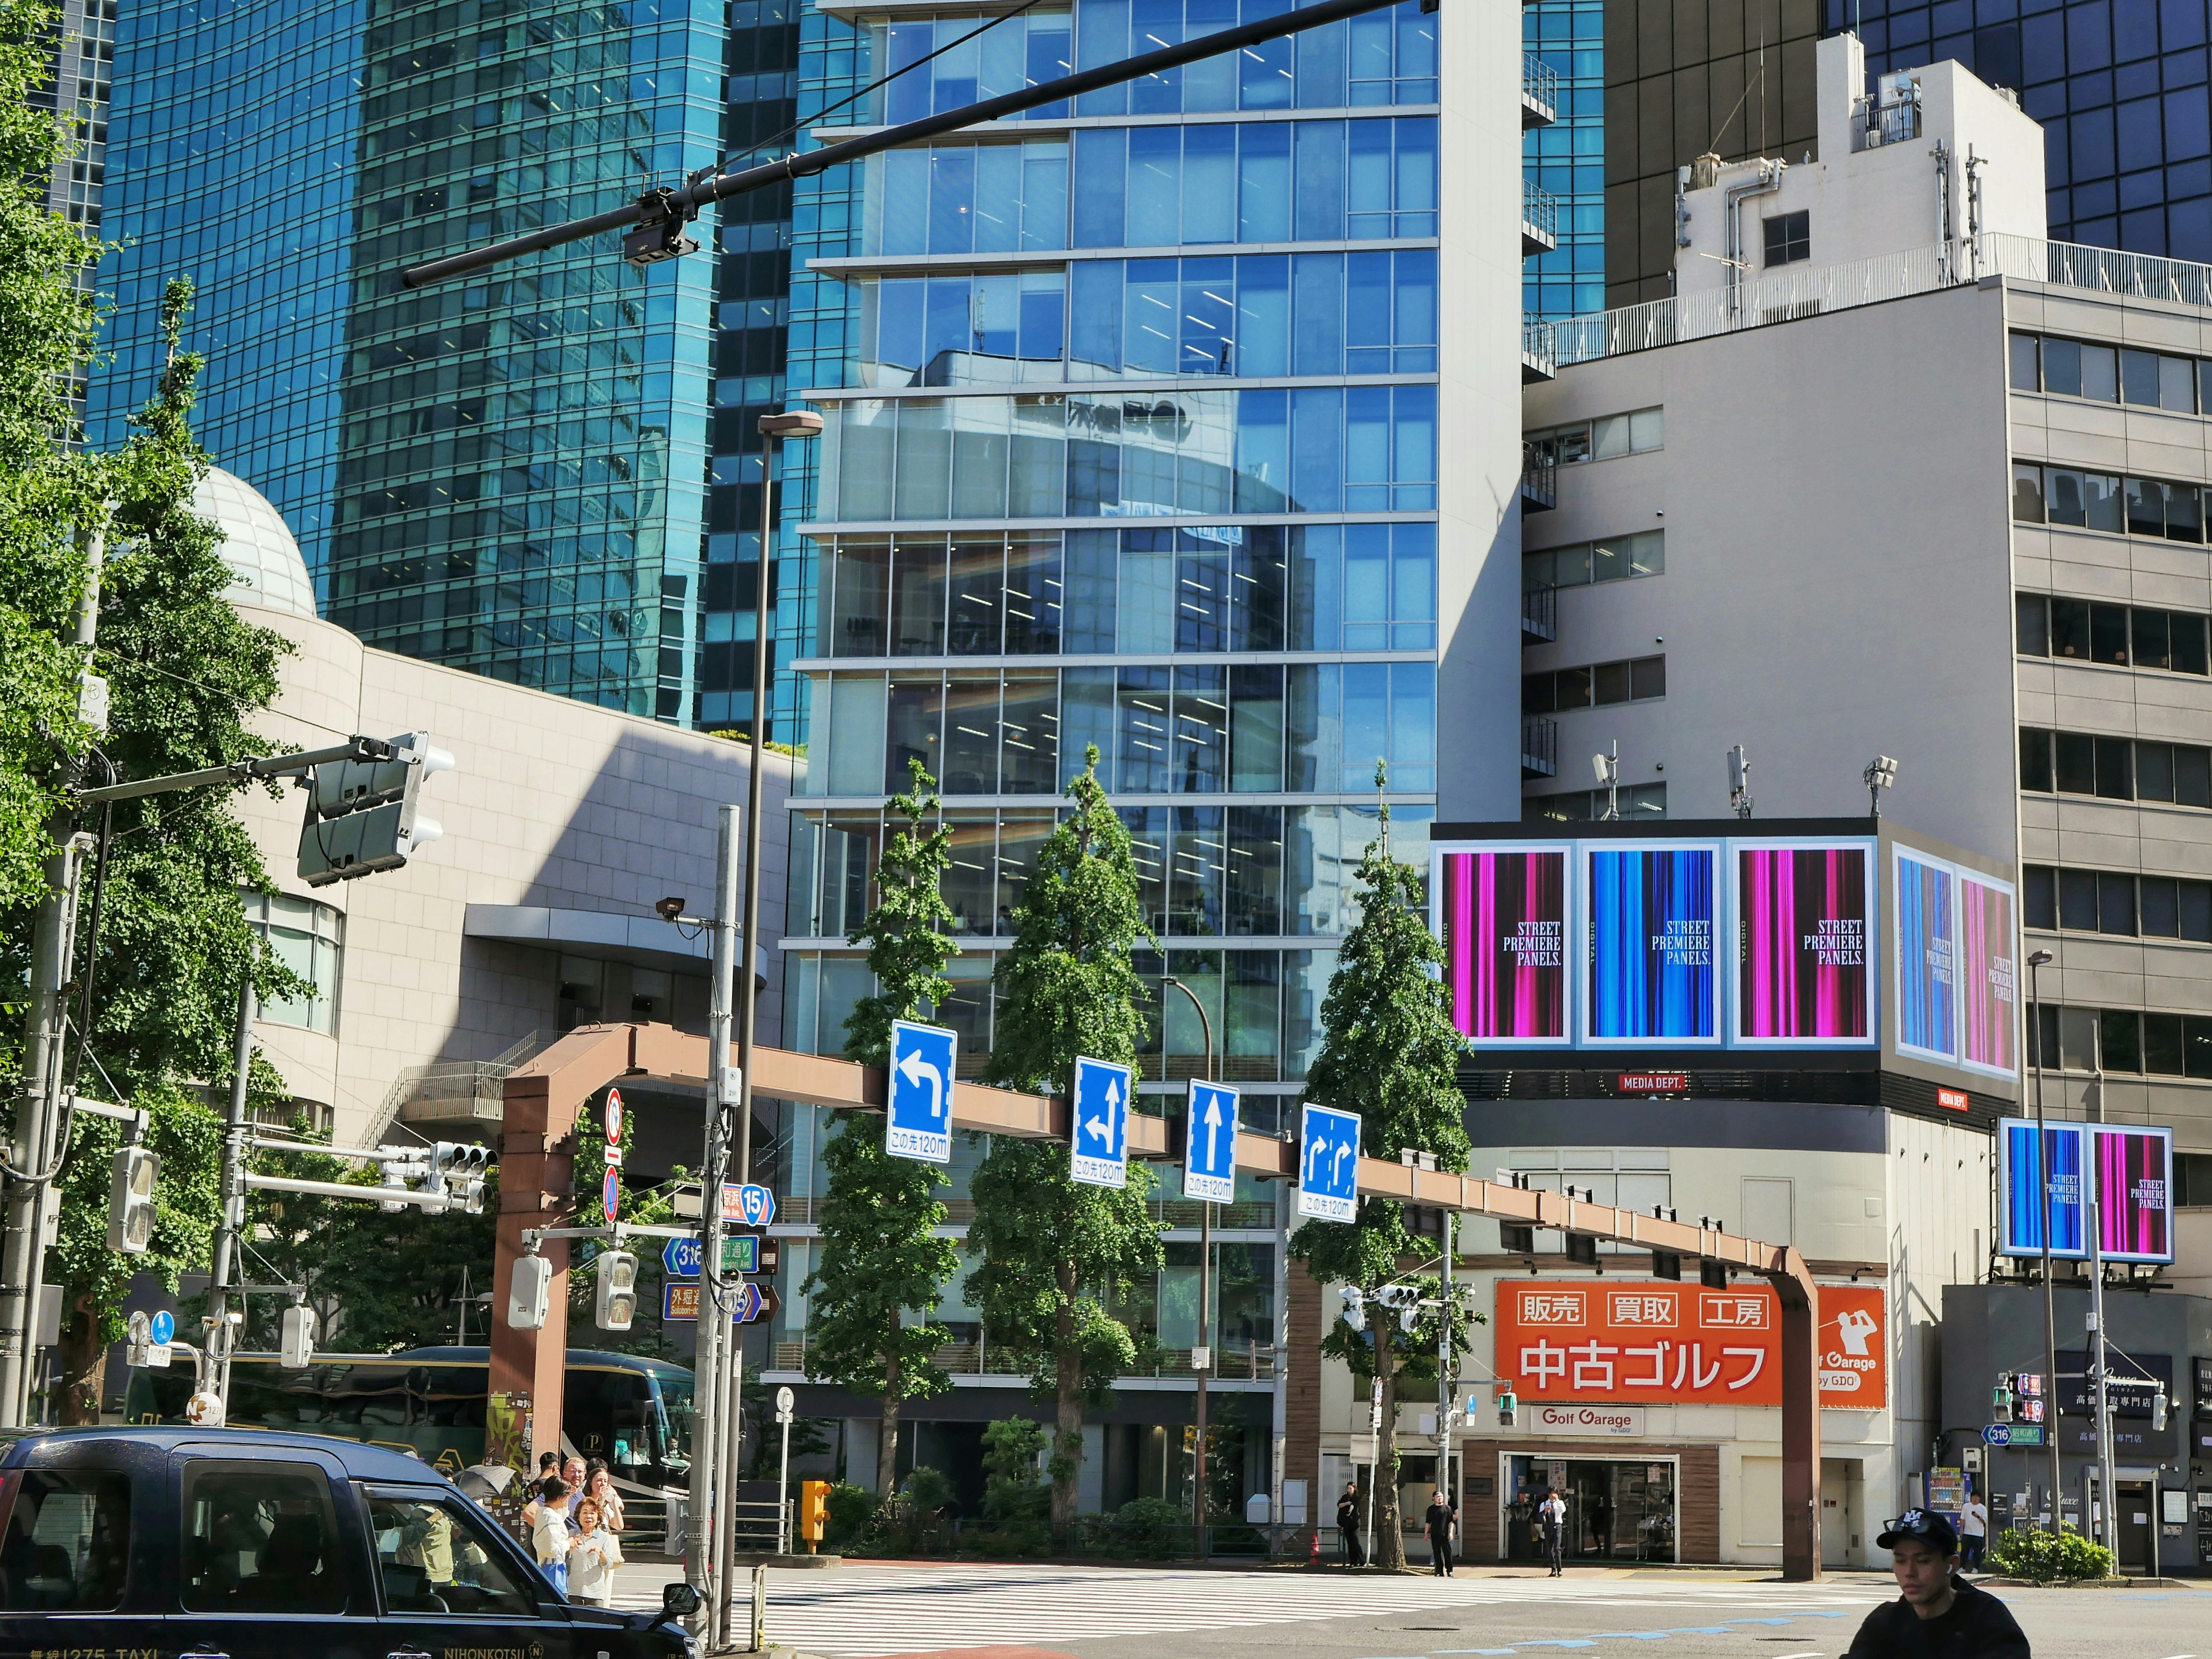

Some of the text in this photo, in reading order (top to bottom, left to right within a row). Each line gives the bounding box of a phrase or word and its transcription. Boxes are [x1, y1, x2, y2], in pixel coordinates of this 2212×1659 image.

[1518, 921, 1560, 936] STREET
[1667, 920, 1709, 935] STREET
[1819, 920, 1862, 934] STREET
[1503, 937, 1560, 951] PREMIERE
[1652, 936, 1709, 950] PREMIERE
[1804, 935, 1862, 949] PREMIERE
[1932, 937, 1951, 955] STREET
[1518, 952, 1561, 966] PANELS.
[1667, 951, 1711, 965] PANELS.
[1819, 950, 1863, 965] PANELS.
[1926, 949, 1952, 970] PREMIERE
[1993, 955, 2011, 973] STREET
[1988, 968, 2012, 988] PREMIERE
[1624, 1077, 1682, 1089] MEDIA DEPT.
[1940, 1092, 1966, 1108] MEDIA DEPT.
[890, 1132, 947, 1156] この先120m
[1075, 1159, 1123, 1181] この先120m
[2053, 1174, 2078, 1184] STREET
[2138, 1179, 2164, 1189] STREET
[1188, 1177, 1231, 1198] この先120m
[2046, 1183, 2078, 1194] PREMIERE
[2131, 1188, 2164, 1200] PREMIERE
[744, 1190, 761, 1214] 15
[2053, 1194, 2079, 1204] PANELS.
[2139, 1200, 2165, 1210] PANELS.
[1306, 1197, 1349, 1217] この先120m
[740, 1260, 751, 1269] Ave.
[1524, 1296, 1580, 1322] 販売
[1614, 1297, 1672, 1324] 買取
[1705, 1298, 1763, 1326] 工房
[1520, 1339, 1766, 1390] 中古ゴルフ
[1827, 1351, 1876, 1371] Garage
[2076, 1394, 2151, 1407] 高価取専門店
[1543, 1408, 1631, 1428] Golf Garage
[1992, 1429, 2008, 1441] 316
[64, 1649, 105, 1659] 1275
[116, 1649, 158, 1659] TAXI
[444, 1648, 524, 1659] NIHONKOTSU
